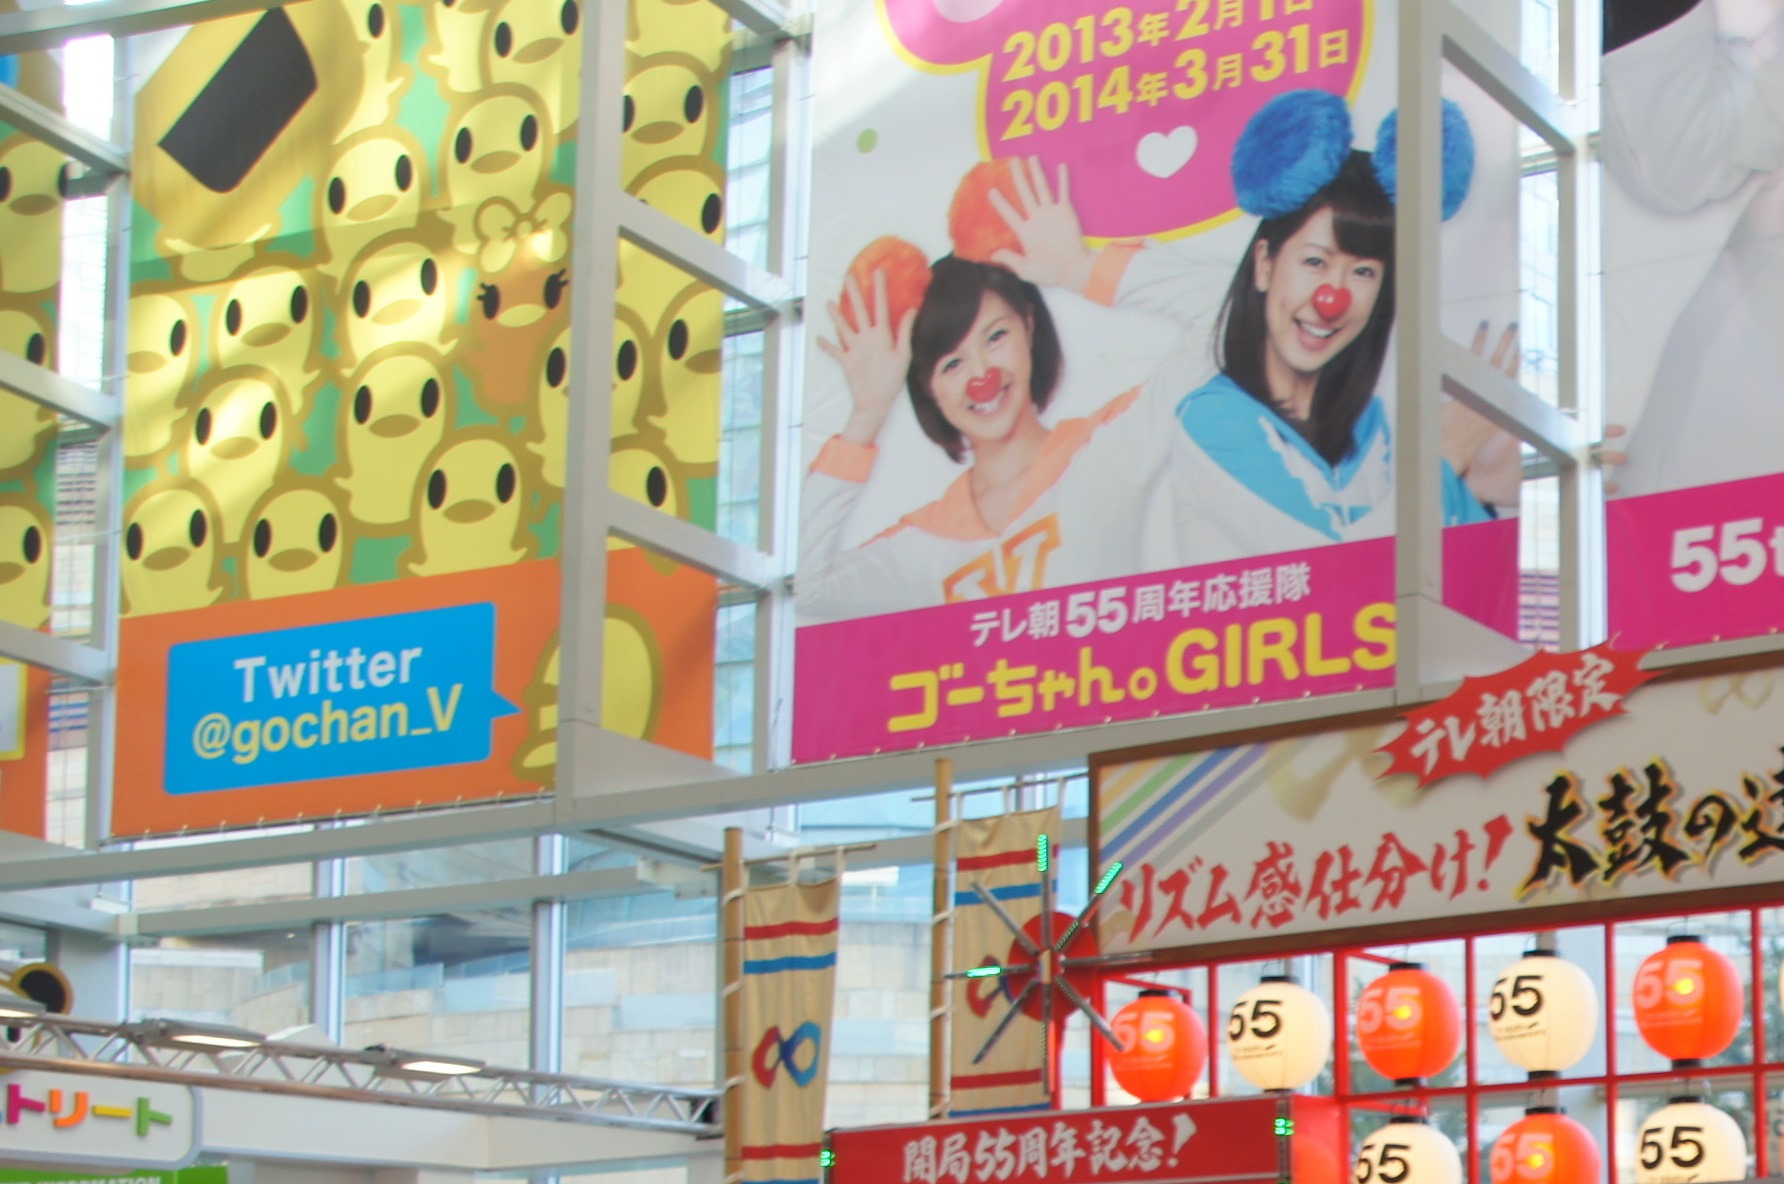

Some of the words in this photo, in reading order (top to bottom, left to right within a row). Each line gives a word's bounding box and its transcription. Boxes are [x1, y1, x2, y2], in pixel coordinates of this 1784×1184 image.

[1000, 23, 1350, 141] 2014年3月31日
[970, 565, 1312, 646] テレ朝55周年応援隊
[232, 645, 422, 702] Twitter
[887, 601, 1397, 733] ゴーちゃん。GIRLS
[192, 684, 463, 764] @gochan_V
[1408, 653, 1622, 774] テレ朝限定
[1119, 812, 1514, 945] リズム感仕分け!
[1229, 999, 1283, 1041] 55
[1490, 974, 1544, 1020] 55
[0, 1084, 174, 1137] トリート
[1640, 1125, 1707, 1170] 55
